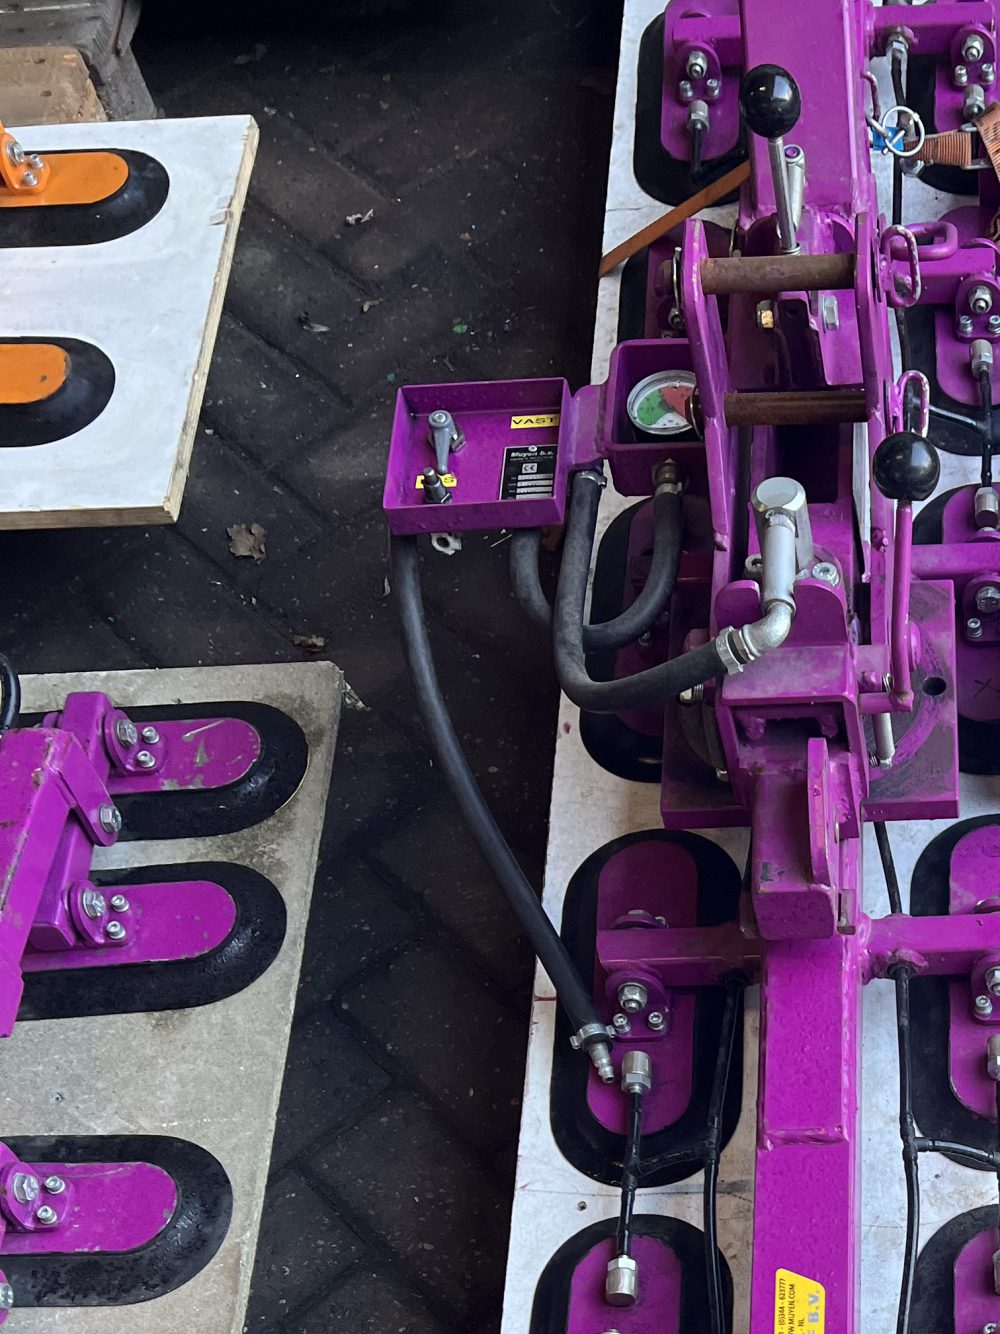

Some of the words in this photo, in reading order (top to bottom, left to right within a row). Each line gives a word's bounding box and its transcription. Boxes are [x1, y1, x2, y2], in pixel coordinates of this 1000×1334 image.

[512, 417, 555, 425] VAST
[778, 1278, 786, 1301] 623777
[778, 1305, 786, 1326] (0)344
[807, 1290, 820, 1324] B.V.
[797, 1318, 805, 1327] NL
